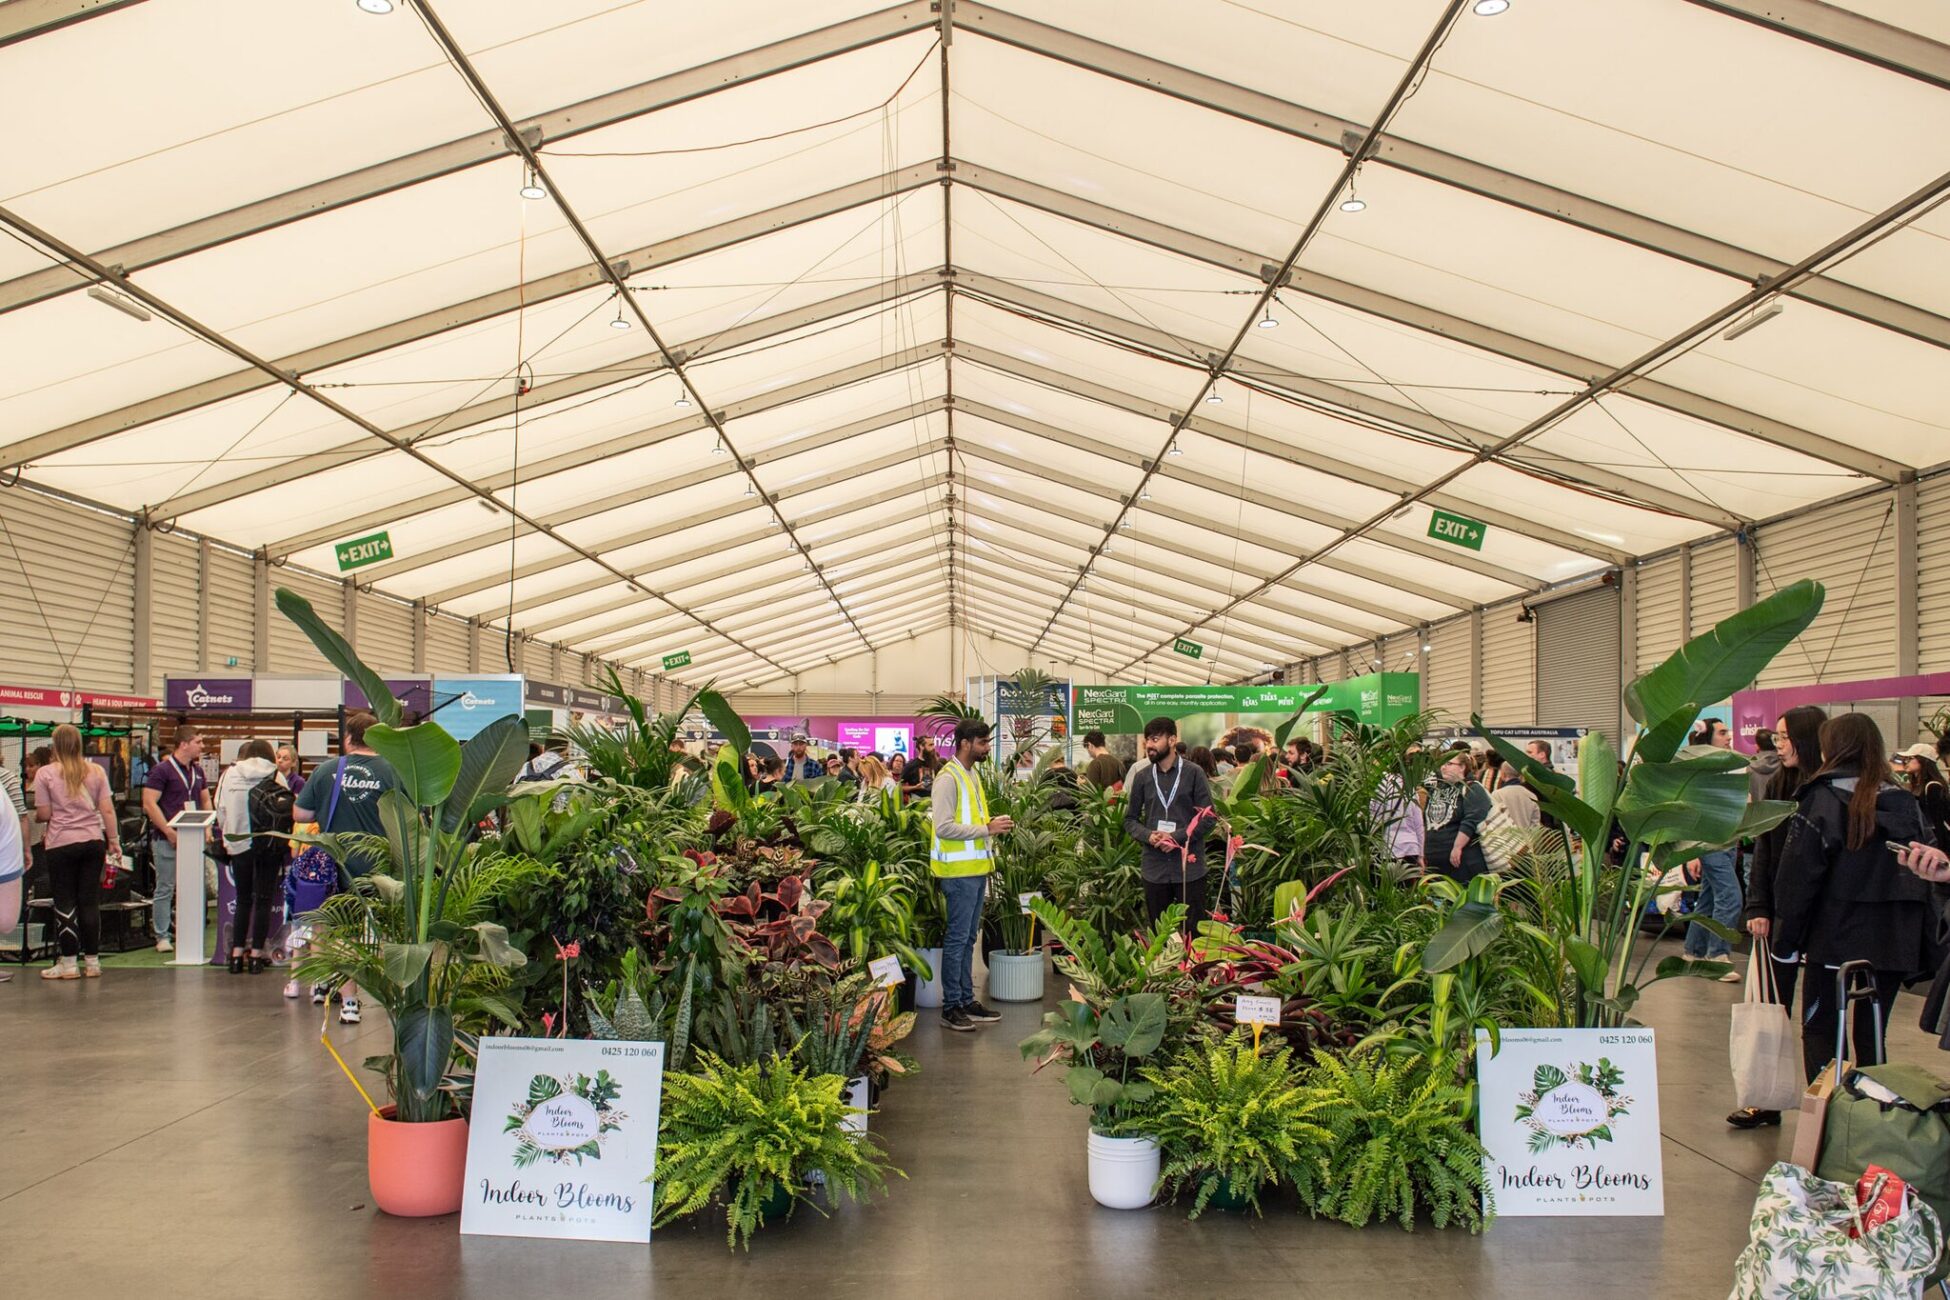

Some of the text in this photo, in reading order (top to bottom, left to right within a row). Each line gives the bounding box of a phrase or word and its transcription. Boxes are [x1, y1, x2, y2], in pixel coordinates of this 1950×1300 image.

[1434, 518, 1469, 540] EXIT
[348, 540, 380, 562] EXIT
[1177, 641, 1194, 654] EXIT
[669, 655, 686, 666] EXIT
[0, 690, 43, 700] ANIMAL RESCUE
[1083, 689, 1127, 698] NexGard
[92, 698, 107, 706] HEART
[192, 695, 233, 704] Catnets
[1078, 708, 1114, 718] NexGard
[1600, 1035, 1620, 1044] 0425
[1621, 1035, 1636, 1044] 120
[1637, 1035, 1653, 1044] 060
[601, 1047, 622, 1056] 0425
[624, 1047, 640, 1057] 120
[640, 1048, 657, 1057] 060
[1552, 1093, 1580, 1104] Indoor
[544, 1105, 573, 1117] Indoor
[1560, 1104, 1593, 1115] Blooms
[550, 1116, 584, 1129] Blooms
[1497, 1165, 1652, 1190] Indoor Blooms
[480, 1179, 637, 1213] Indoor Blooms
[515, 1214, 557, 1222] PLANTS
